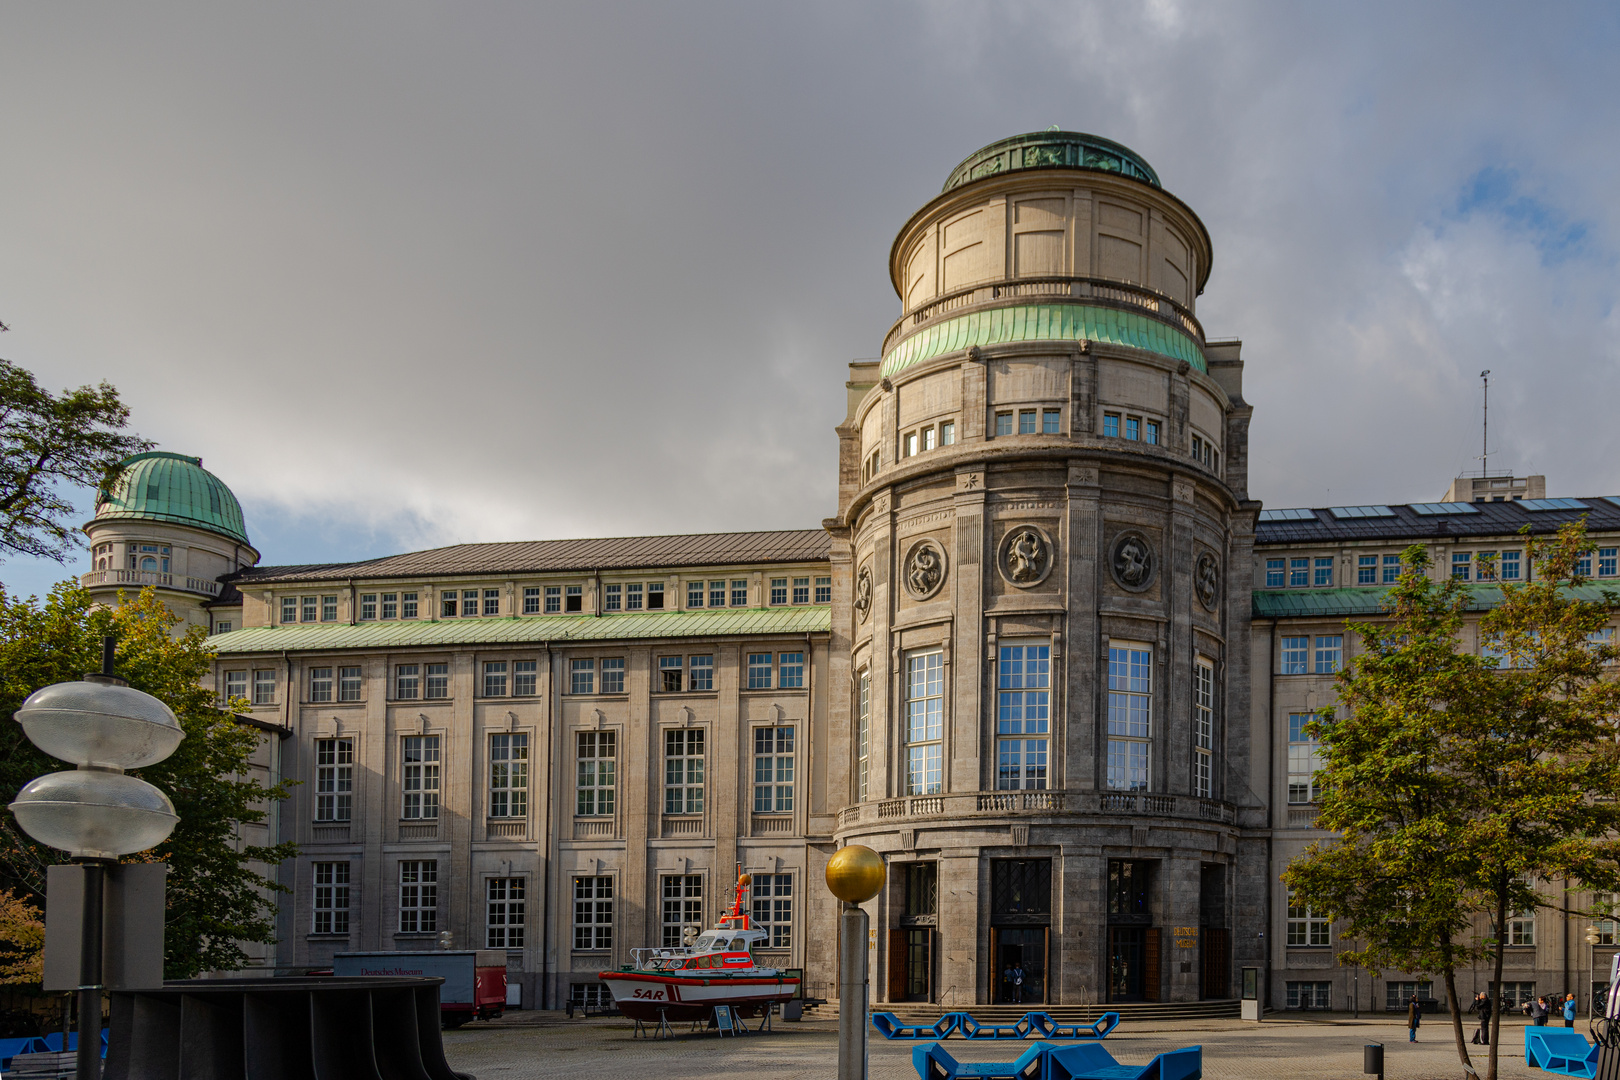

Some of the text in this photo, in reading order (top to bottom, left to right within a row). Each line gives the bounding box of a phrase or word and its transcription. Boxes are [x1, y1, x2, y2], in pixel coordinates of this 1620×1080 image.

[1174, 927, 1198, 936] DEUTSCHES
[1176, 940, 1196, 948] MUSEUM
[361, 968, 393, 976] Deutsches
[632, 988, 664, 1000] SAR
